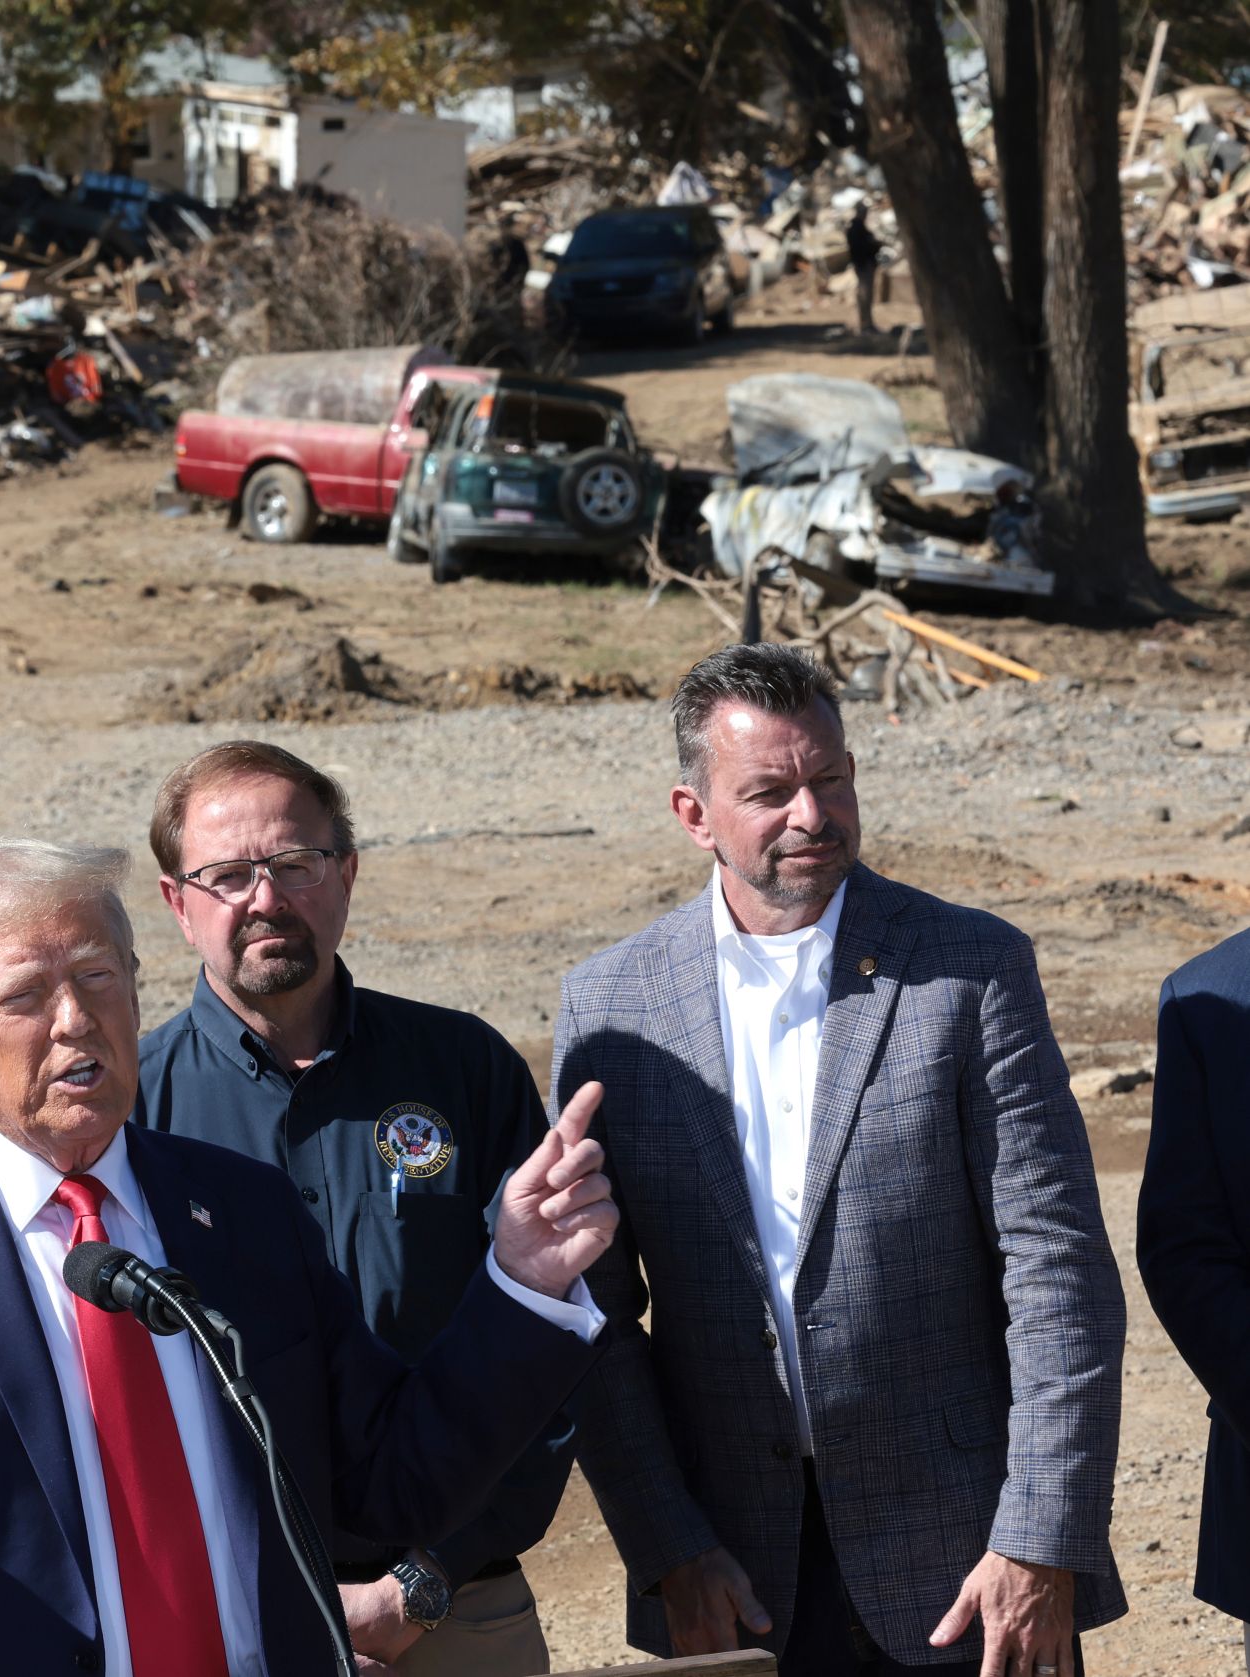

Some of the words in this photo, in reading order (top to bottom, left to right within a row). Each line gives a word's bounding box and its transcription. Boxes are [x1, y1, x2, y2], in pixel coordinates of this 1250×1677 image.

[397, 1104, 433, 1119] HOUSE
[434, 1116, 448, 1128] OF
[379, 1140, 451, 1175] REPRSENTATIVES
